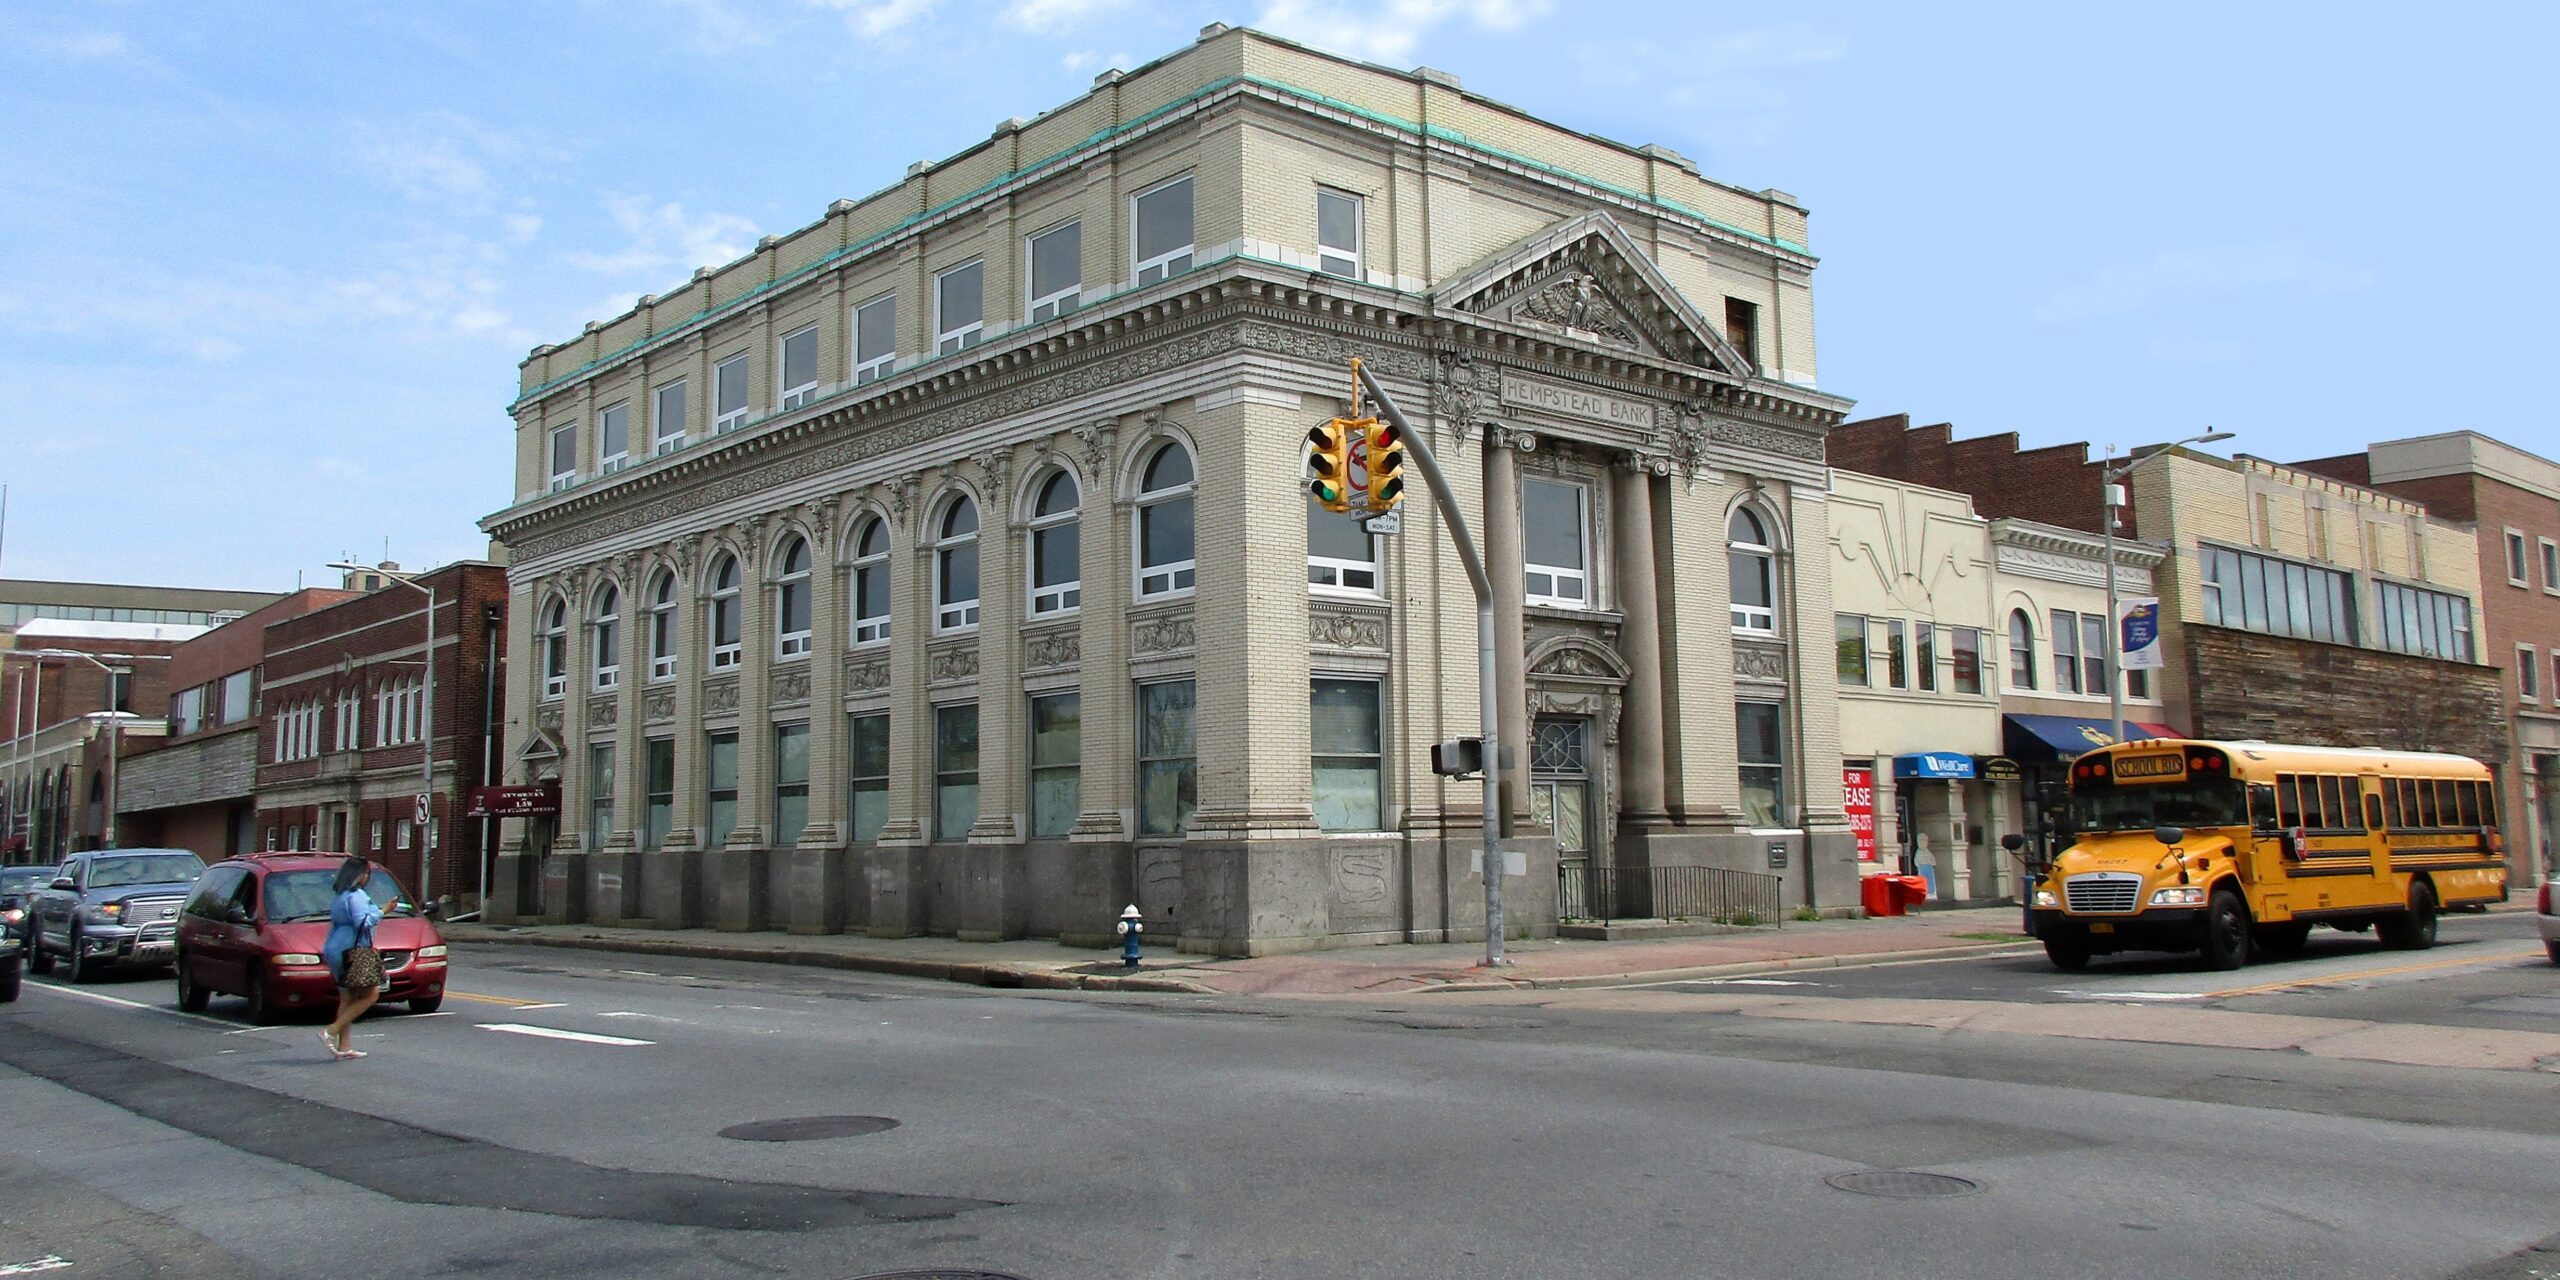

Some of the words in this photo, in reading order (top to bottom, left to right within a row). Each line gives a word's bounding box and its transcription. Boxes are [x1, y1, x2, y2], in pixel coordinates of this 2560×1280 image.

[1507, 379, 1601, 414] HEMPSTEAD
[1610, 402, 1648, 424] BANK
[1938, 760, 1969, 772] WellCare
[2118, 760, 2156, 776] SCHOOL
[2162, 757, 2182, 773] BUS
[1848, 773, 1861, 784] FOR
[1844, 787, 1872, 806] EASE
